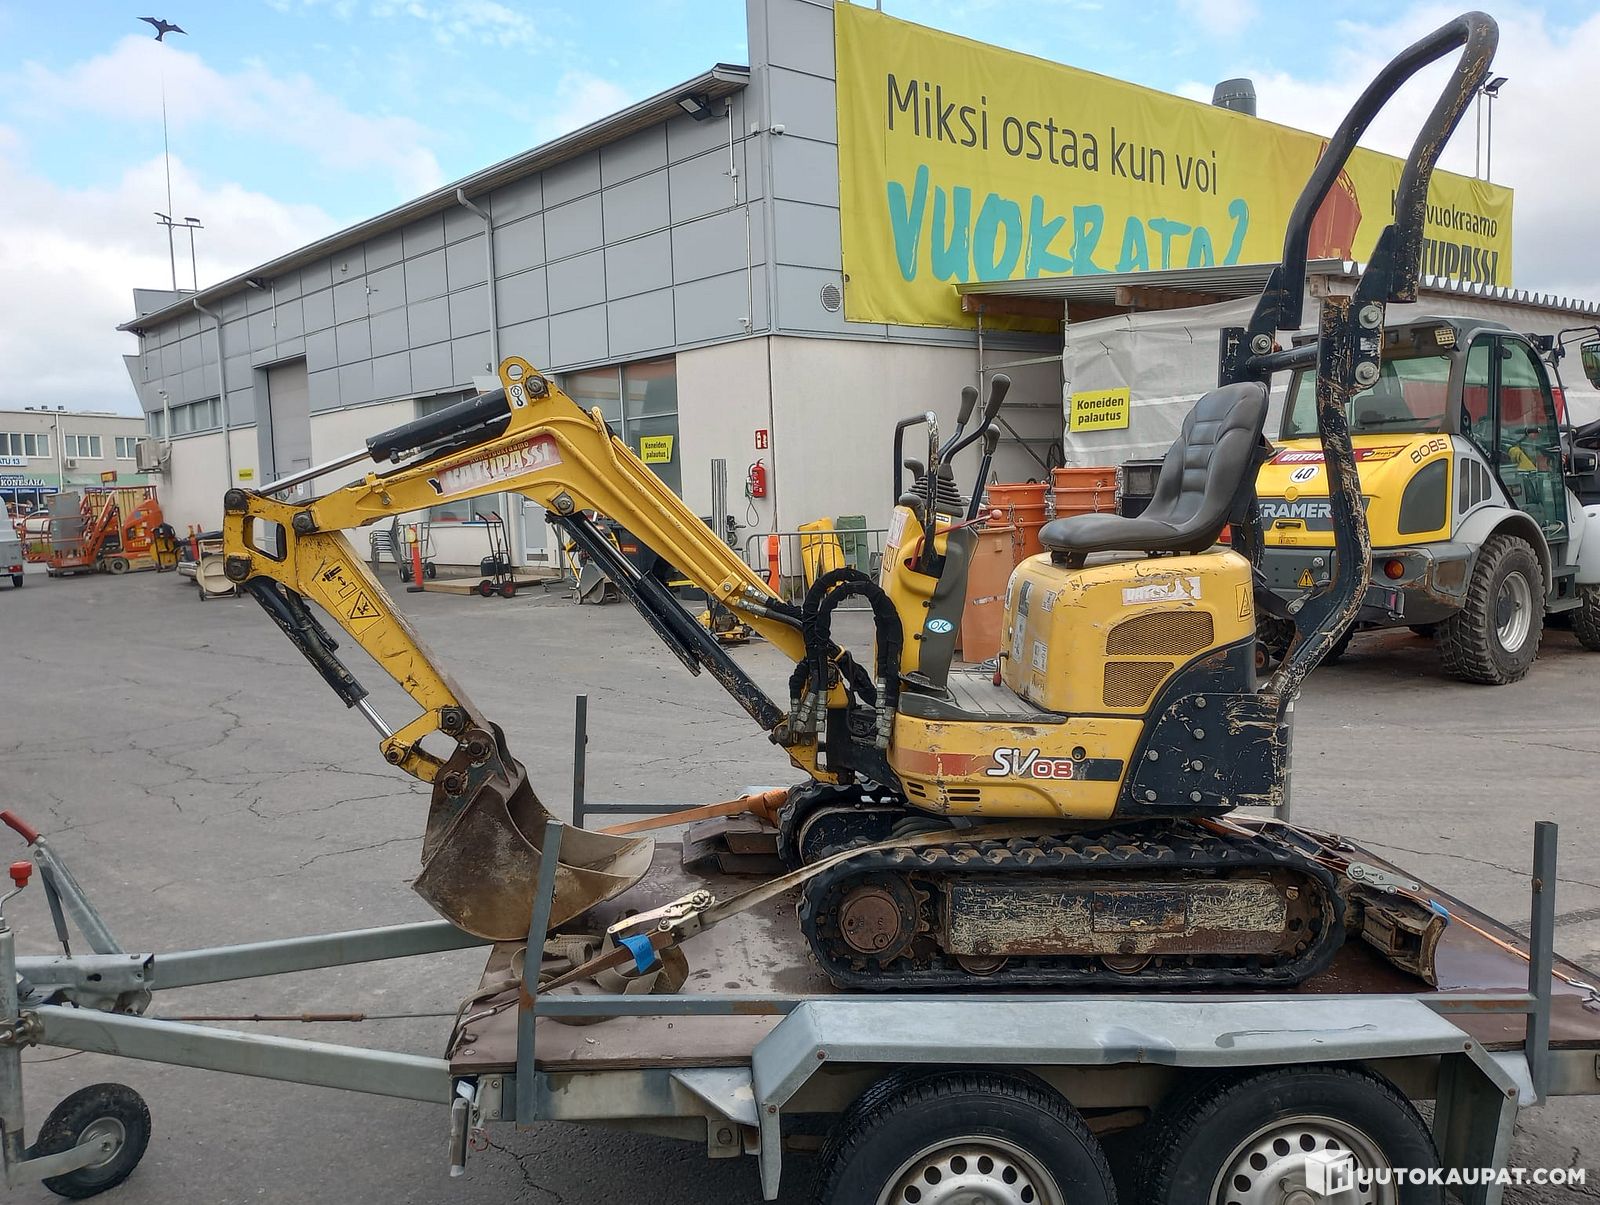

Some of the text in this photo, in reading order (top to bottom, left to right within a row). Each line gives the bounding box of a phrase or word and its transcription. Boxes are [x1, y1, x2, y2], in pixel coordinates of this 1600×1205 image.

[887, 73, 1218, 195] Miksi ostaa kun voi
[1077, 396, 1124, 410] Koneiden
[1078, 411, 1122, 426] palautus
[1410, 438, 1448, 465] 8085
[1294, 467, 1315, 480] 40
[931, 620, 949, 632] OK
